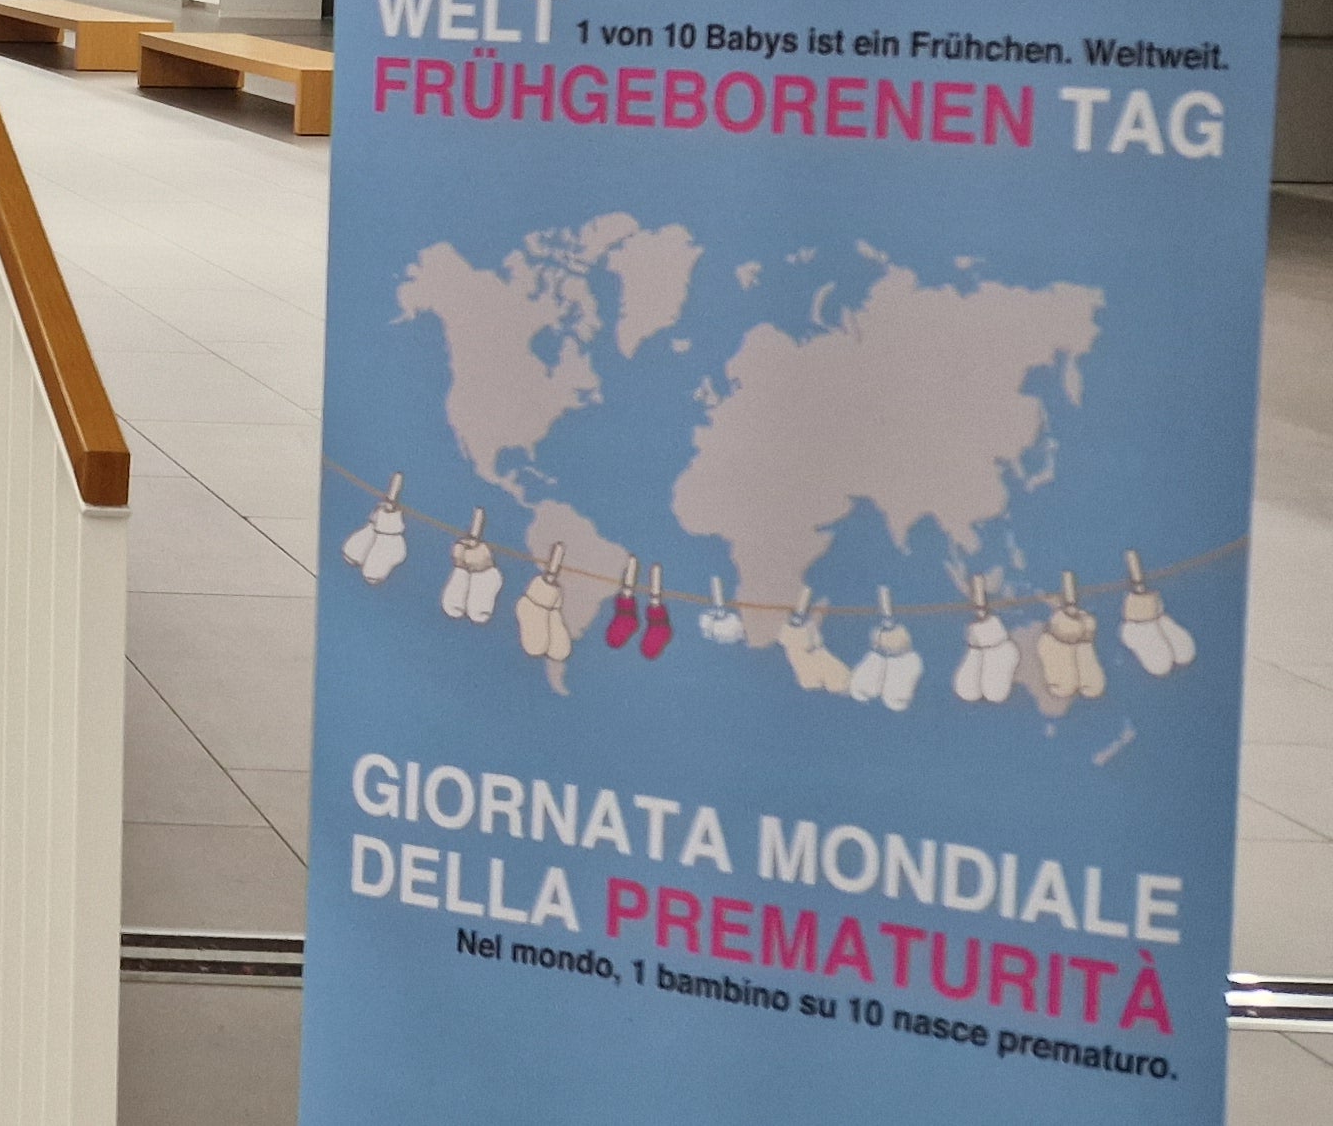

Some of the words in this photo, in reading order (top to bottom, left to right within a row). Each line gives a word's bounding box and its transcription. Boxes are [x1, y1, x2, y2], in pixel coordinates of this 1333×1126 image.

[374, 47, 1036, 148] FRÜHGEBORENEN
[1060, 86, 1225, 159] TAG
[577, 20, 590, 44] 1
[602, 24, 654, 48] von
[665, 23, 696, 49] 10
[706, 24, 799, 60] Babys
[808, 27, 845, 56] ist
[854, 29, 900, 58] ein
[910, 30, 1072, 65] Frühchen.
[1083, 38, 1229, 71] Weltweit.
[352, 752, 733, 875] GIORNATA
[758, 814, 1184, 945] MONDIALE
[350, 833, 580, 933] DELLA
[606, 876, 1174, 1036] PREMATURITÀ
[457, 927, 502, 960] Nel
[511, 942, 621, 985] mondo,
[632, 959, 645, 985] 1
[656, 962, 790, 1012] bambino
[800, 993, 836, 1020] su
[849, 996, 884, 1028] 10
[893, 1008, 989, 1047] nasce
[997, 1029, 1179, 1080] prematuro.
